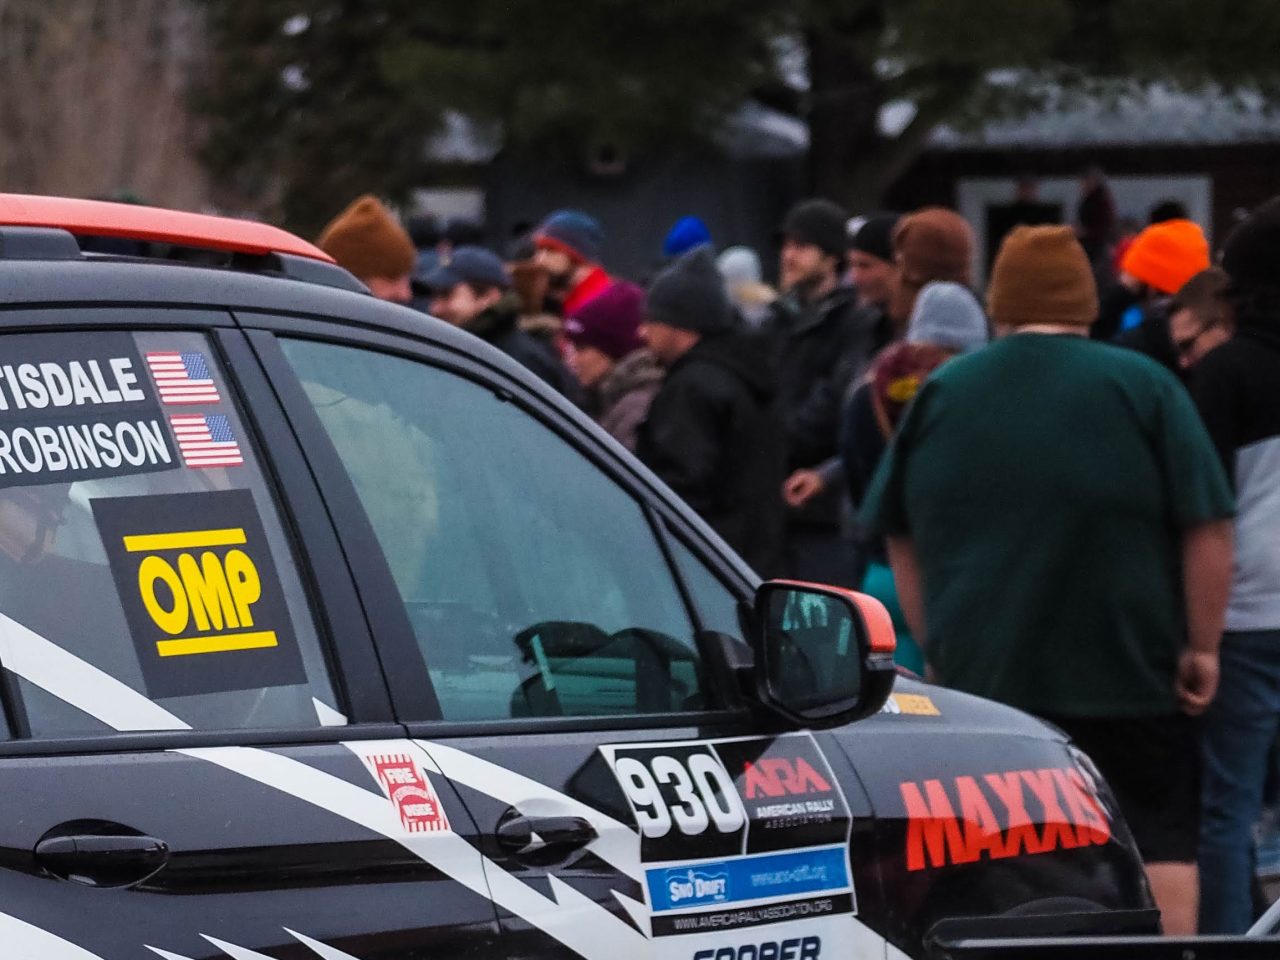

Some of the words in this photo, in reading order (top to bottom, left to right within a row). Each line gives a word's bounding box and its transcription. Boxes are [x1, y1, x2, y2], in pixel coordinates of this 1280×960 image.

[138, 549, 262, 635] OMP
[615, 753, 744, 838] 930
[744, 756, 831, 799] ARA
[756, 803, 805, 819] AMERICAN
[807, 800, 835, 813] RALLY
[765, 814, 833, 829] ASSOCIATION
[899, 767, 1111, 871] MAXXIS
